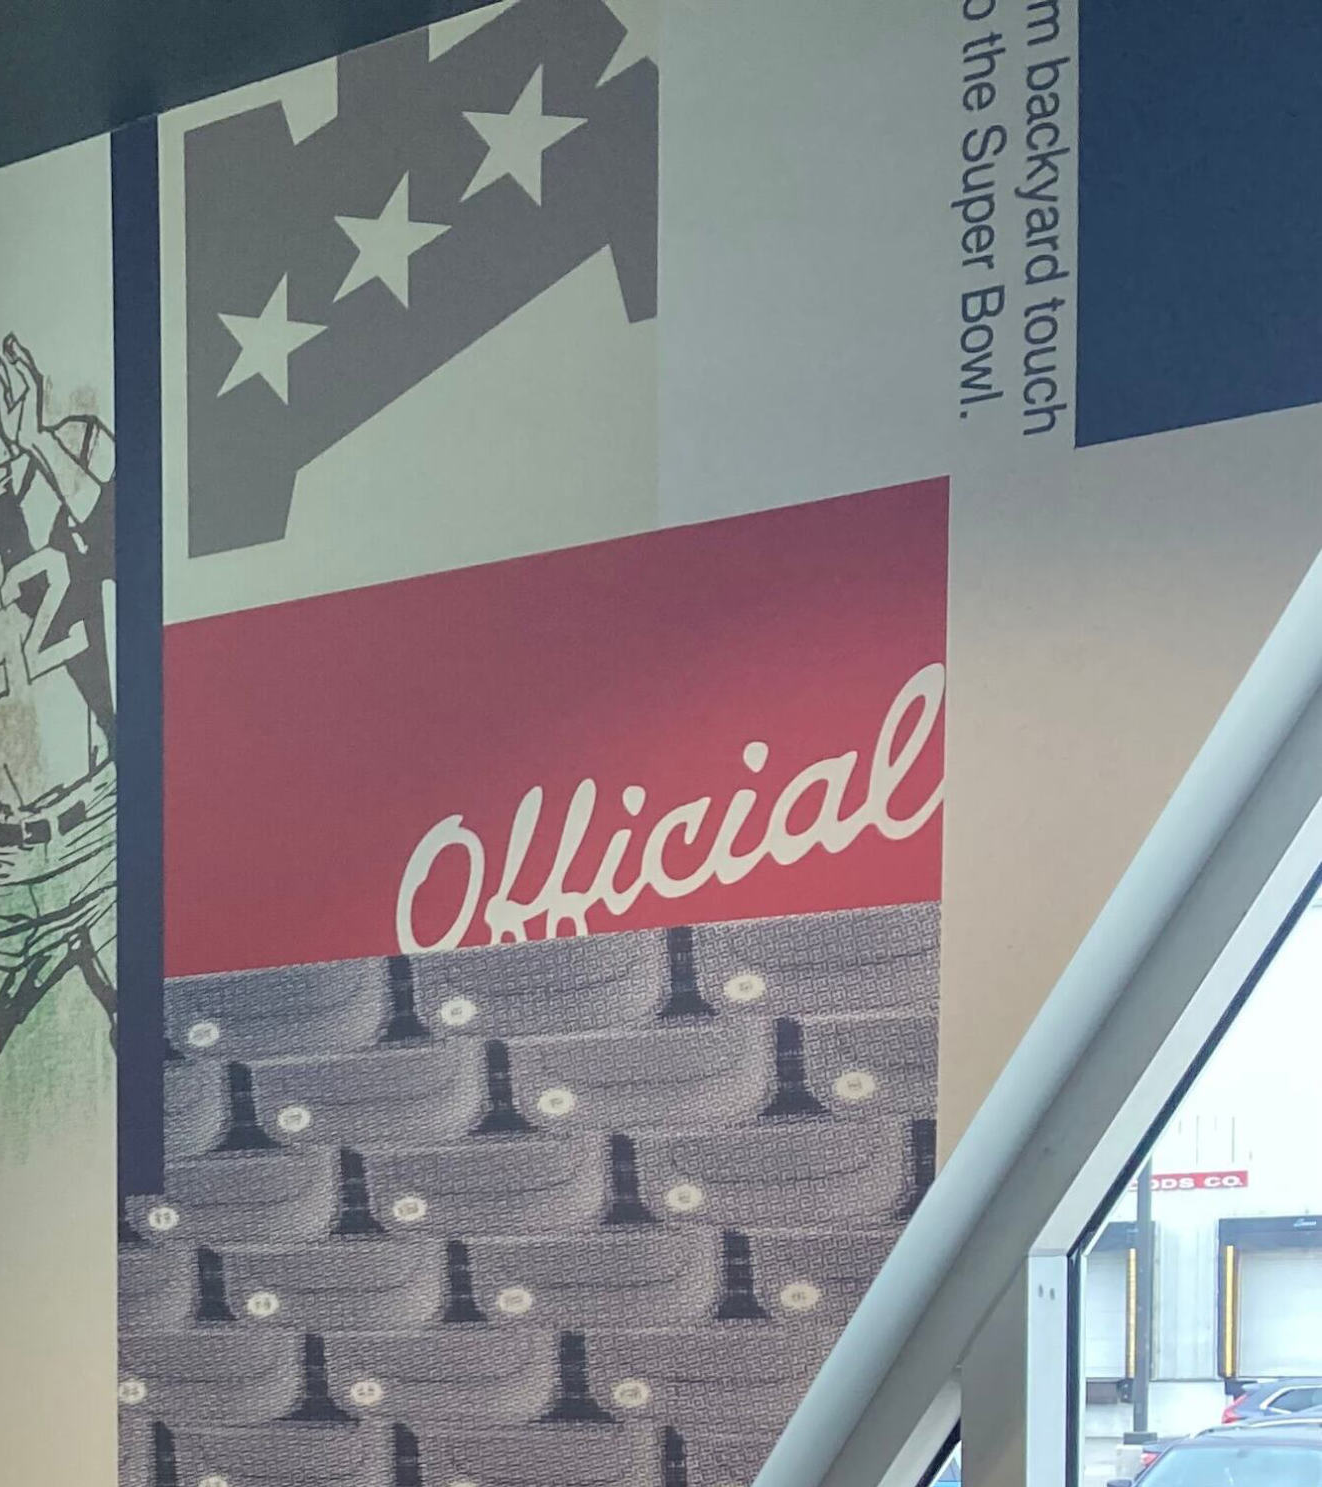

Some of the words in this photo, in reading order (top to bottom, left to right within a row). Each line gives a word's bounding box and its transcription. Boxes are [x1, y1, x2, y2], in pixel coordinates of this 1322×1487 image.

[962, 32, 1006, 112] the
[950, 124, 1007, 271] Super
[1015, 57, 1071, 285] backyard
[960, 285, 1005, 419] Bowl.
[1022, 298, 1067, 436] touch
[397, 662, 945, 954] Official
